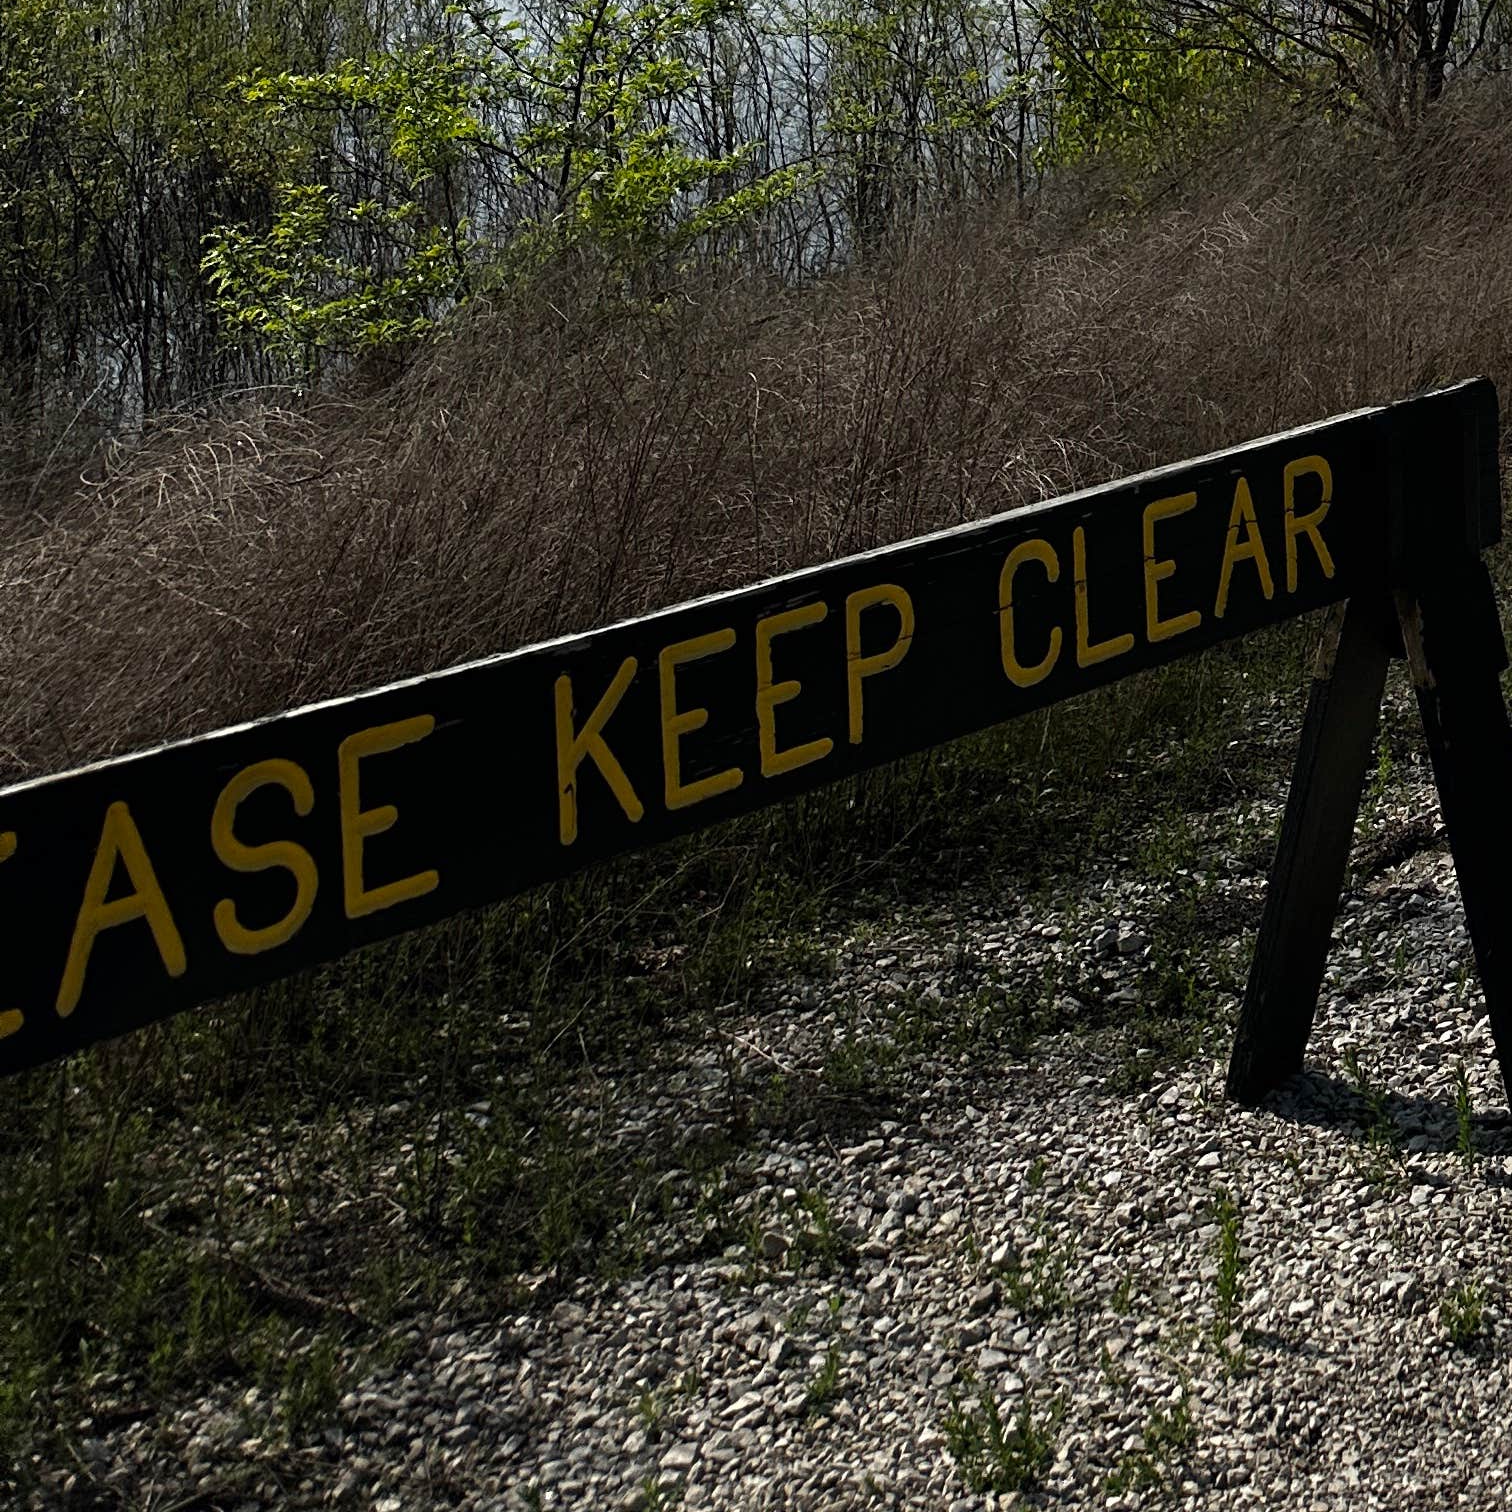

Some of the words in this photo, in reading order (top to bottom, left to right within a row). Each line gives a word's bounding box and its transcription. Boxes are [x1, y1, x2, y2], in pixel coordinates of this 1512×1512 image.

[0, 713, 440, 1040] ASE
[553, 582, 916, 846] KEEP
[999, 454, 1336, 688] CLEAR
